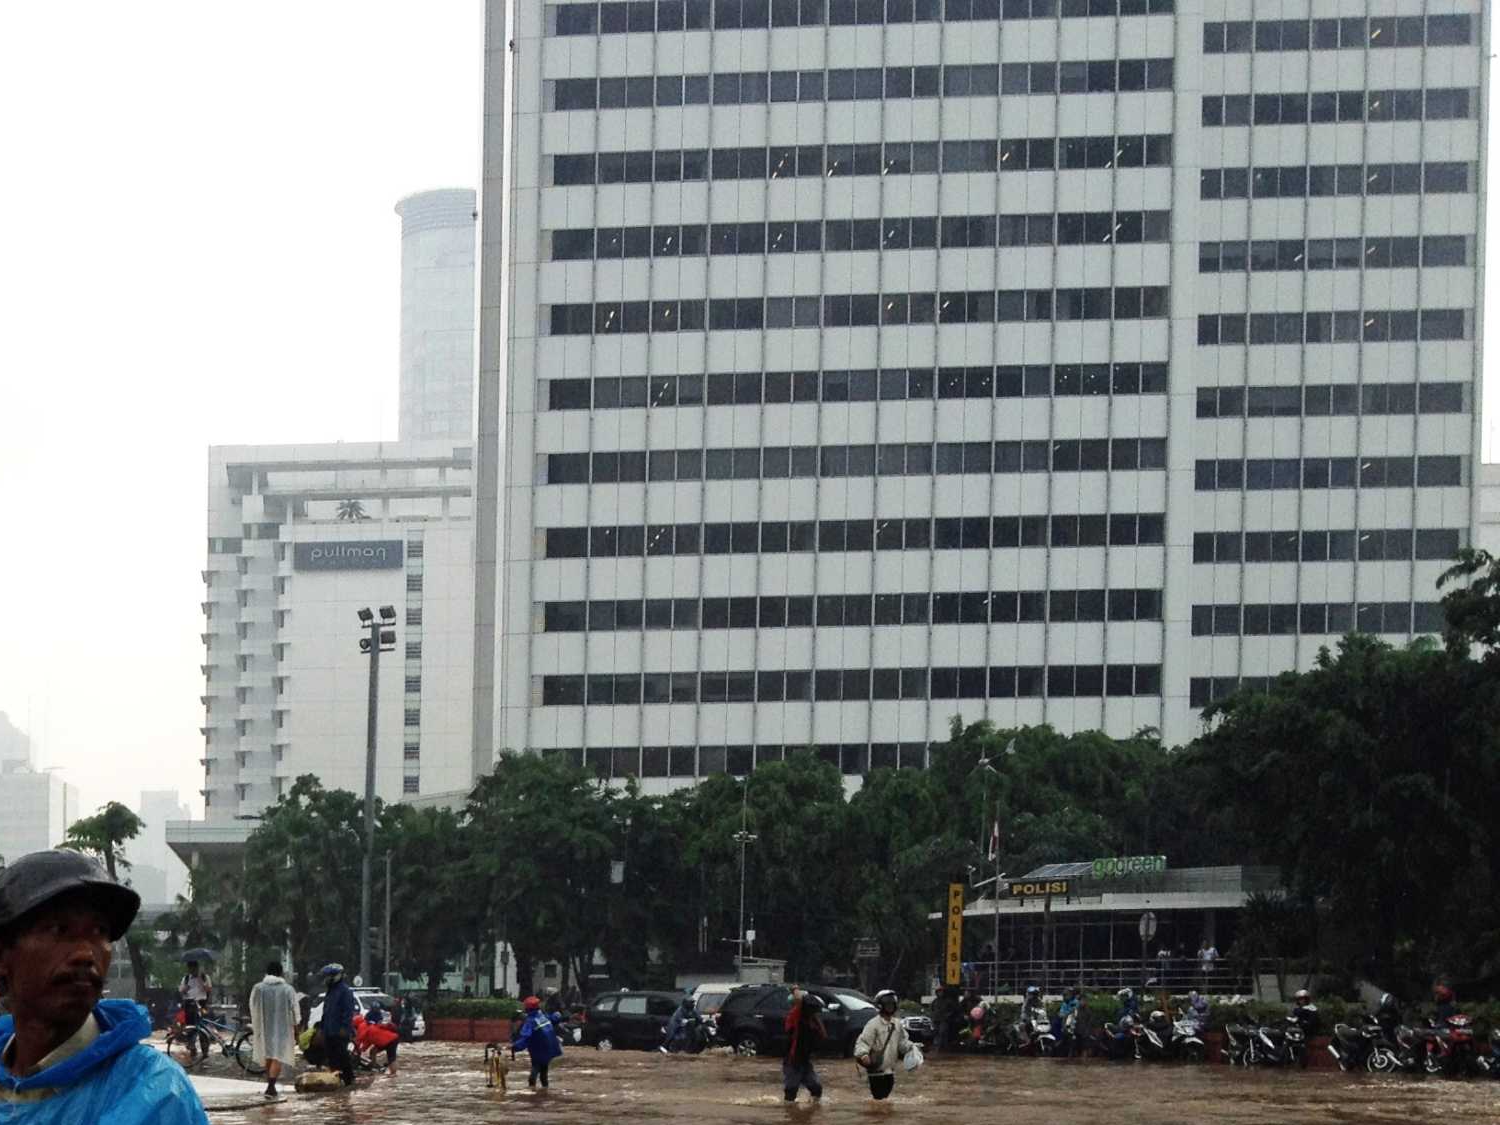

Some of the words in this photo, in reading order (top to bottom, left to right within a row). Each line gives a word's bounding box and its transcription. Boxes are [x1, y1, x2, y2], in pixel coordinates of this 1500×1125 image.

[310, 545, 386, 561] pullman
[1012, 881, 1069, 895] POLISI
[951, 891, 961, 979] POLISI
